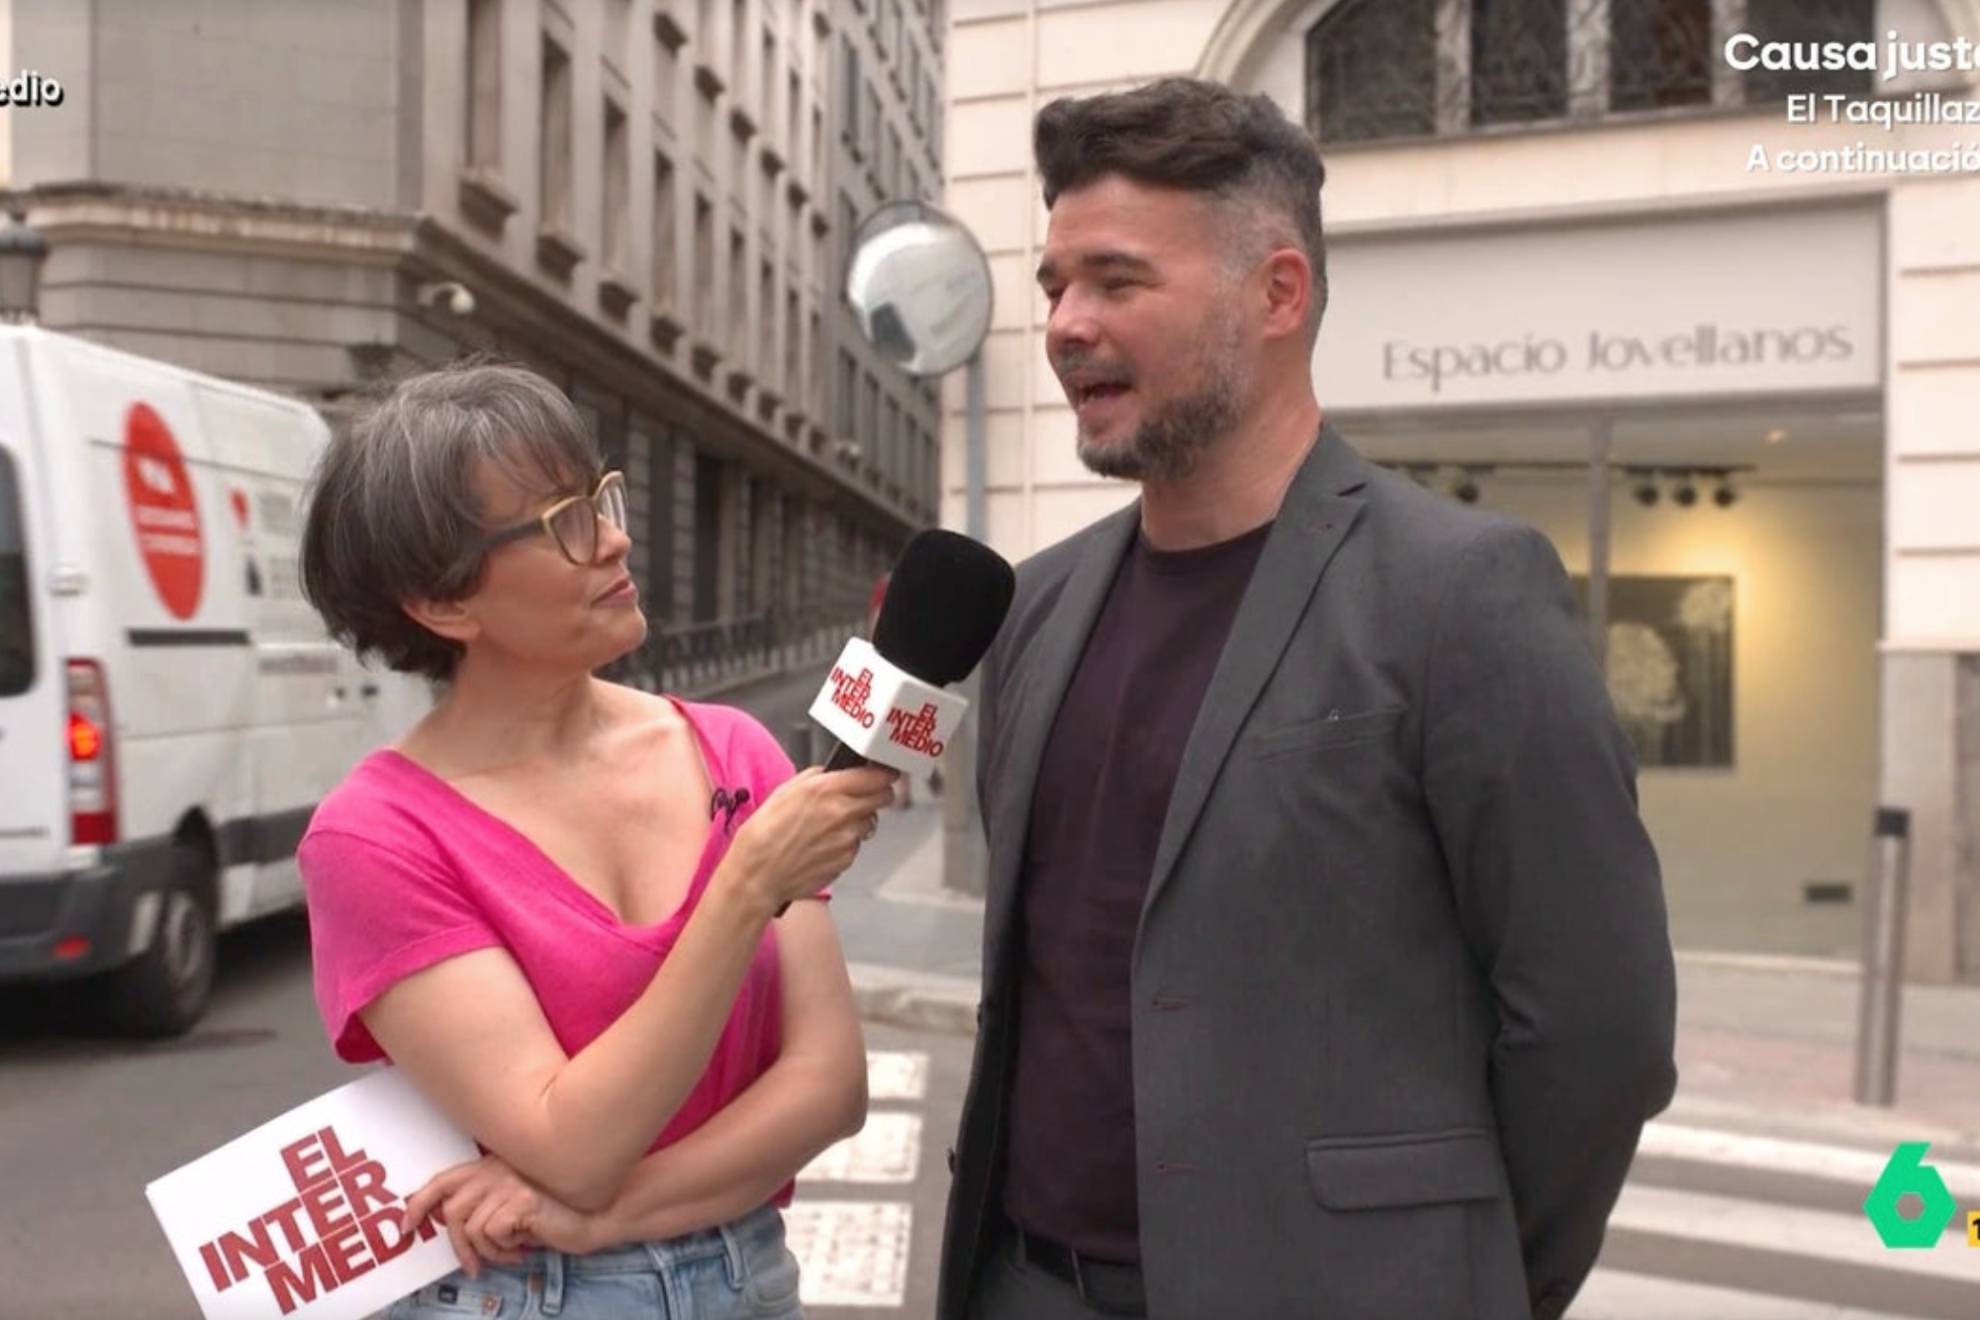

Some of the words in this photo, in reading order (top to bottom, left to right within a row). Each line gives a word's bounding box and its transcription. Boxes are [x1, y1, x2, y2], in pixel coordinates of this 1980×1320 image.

[1383, 332, 1567, 393] Espacio
[1586, 325, 1854, 372] Jovellanos
[831, 667, 871, 705] INTER
[832, 689, 875, 729] MEDIO
[886, 708, 937, 738] INTER
[889, 727, 944, 757] MEDIO
[280, 1125, 367, 1193] EL
[198, 1159, 399, 1293] INTER
[264, 1197, 449, 1316] MEDI
